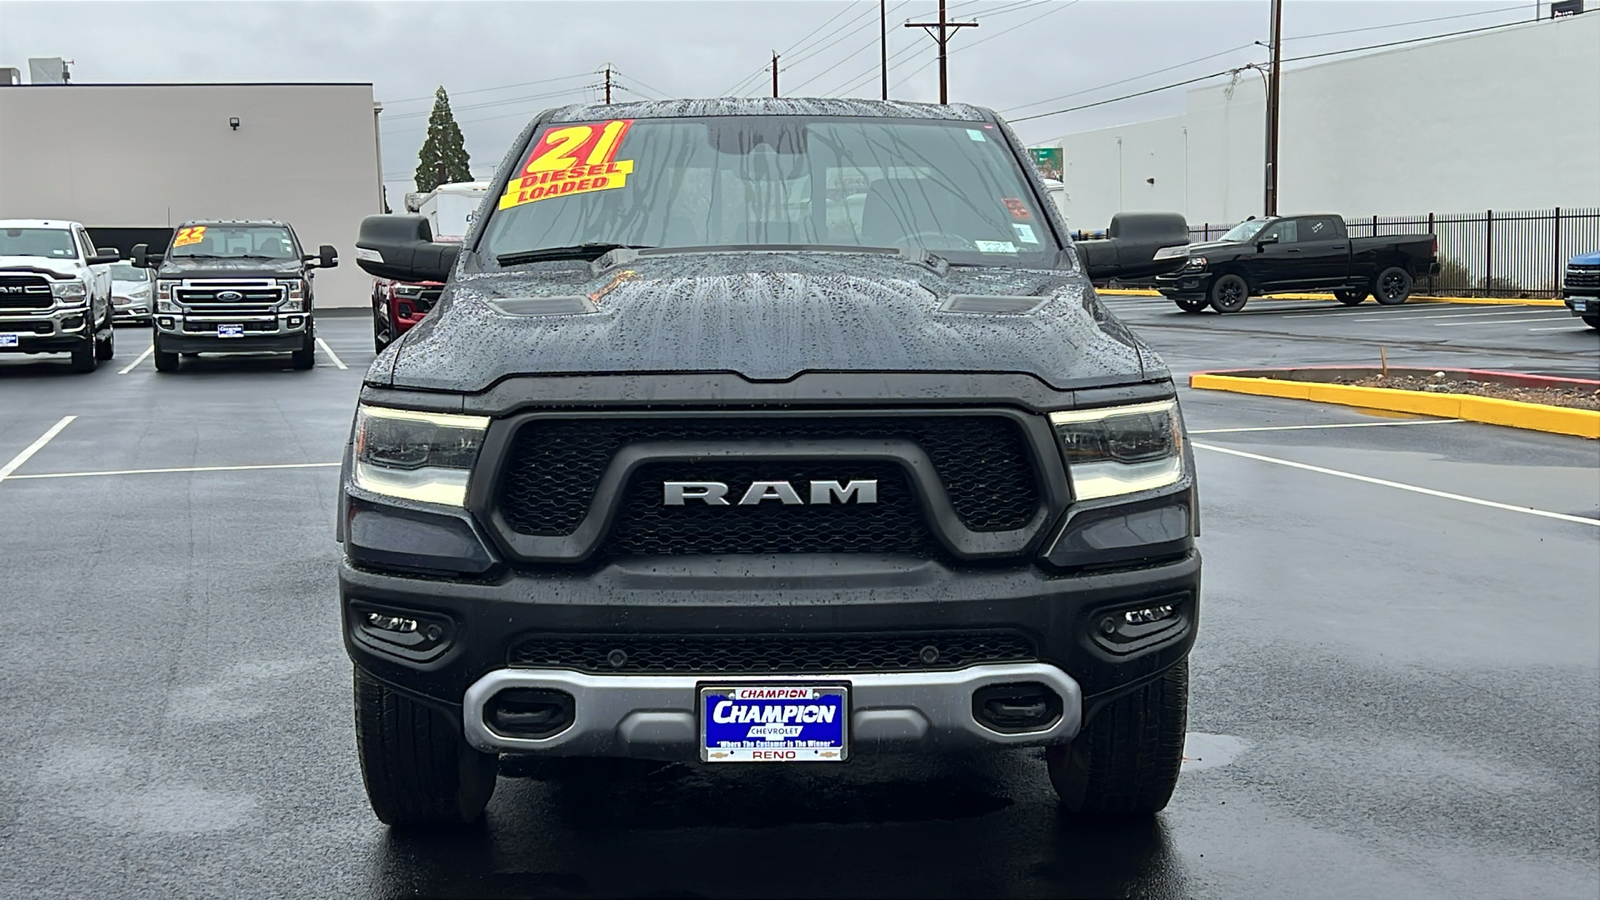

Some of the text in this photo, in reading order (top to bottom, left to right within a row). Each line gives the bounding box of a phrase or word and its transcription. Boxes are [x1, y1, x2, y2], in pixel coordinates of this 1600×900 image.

[526, 121, 624, 173] 21
[520, 162, 621, 189] DIESEL
[518, 177, 609, 203] LOADED
[176, 226, 205, 239] 22
[663, 480, 878, 505] RAM
[740, 689, 808, 699] CHAMPION
[713, 701, 837, 723] CHAMPION
[750, 727, 799, 735] CHEVROLET
[743, 740, 754, 748] The
[795, 740, 806, 748] The
[752, 751, 796, 759] RENO
